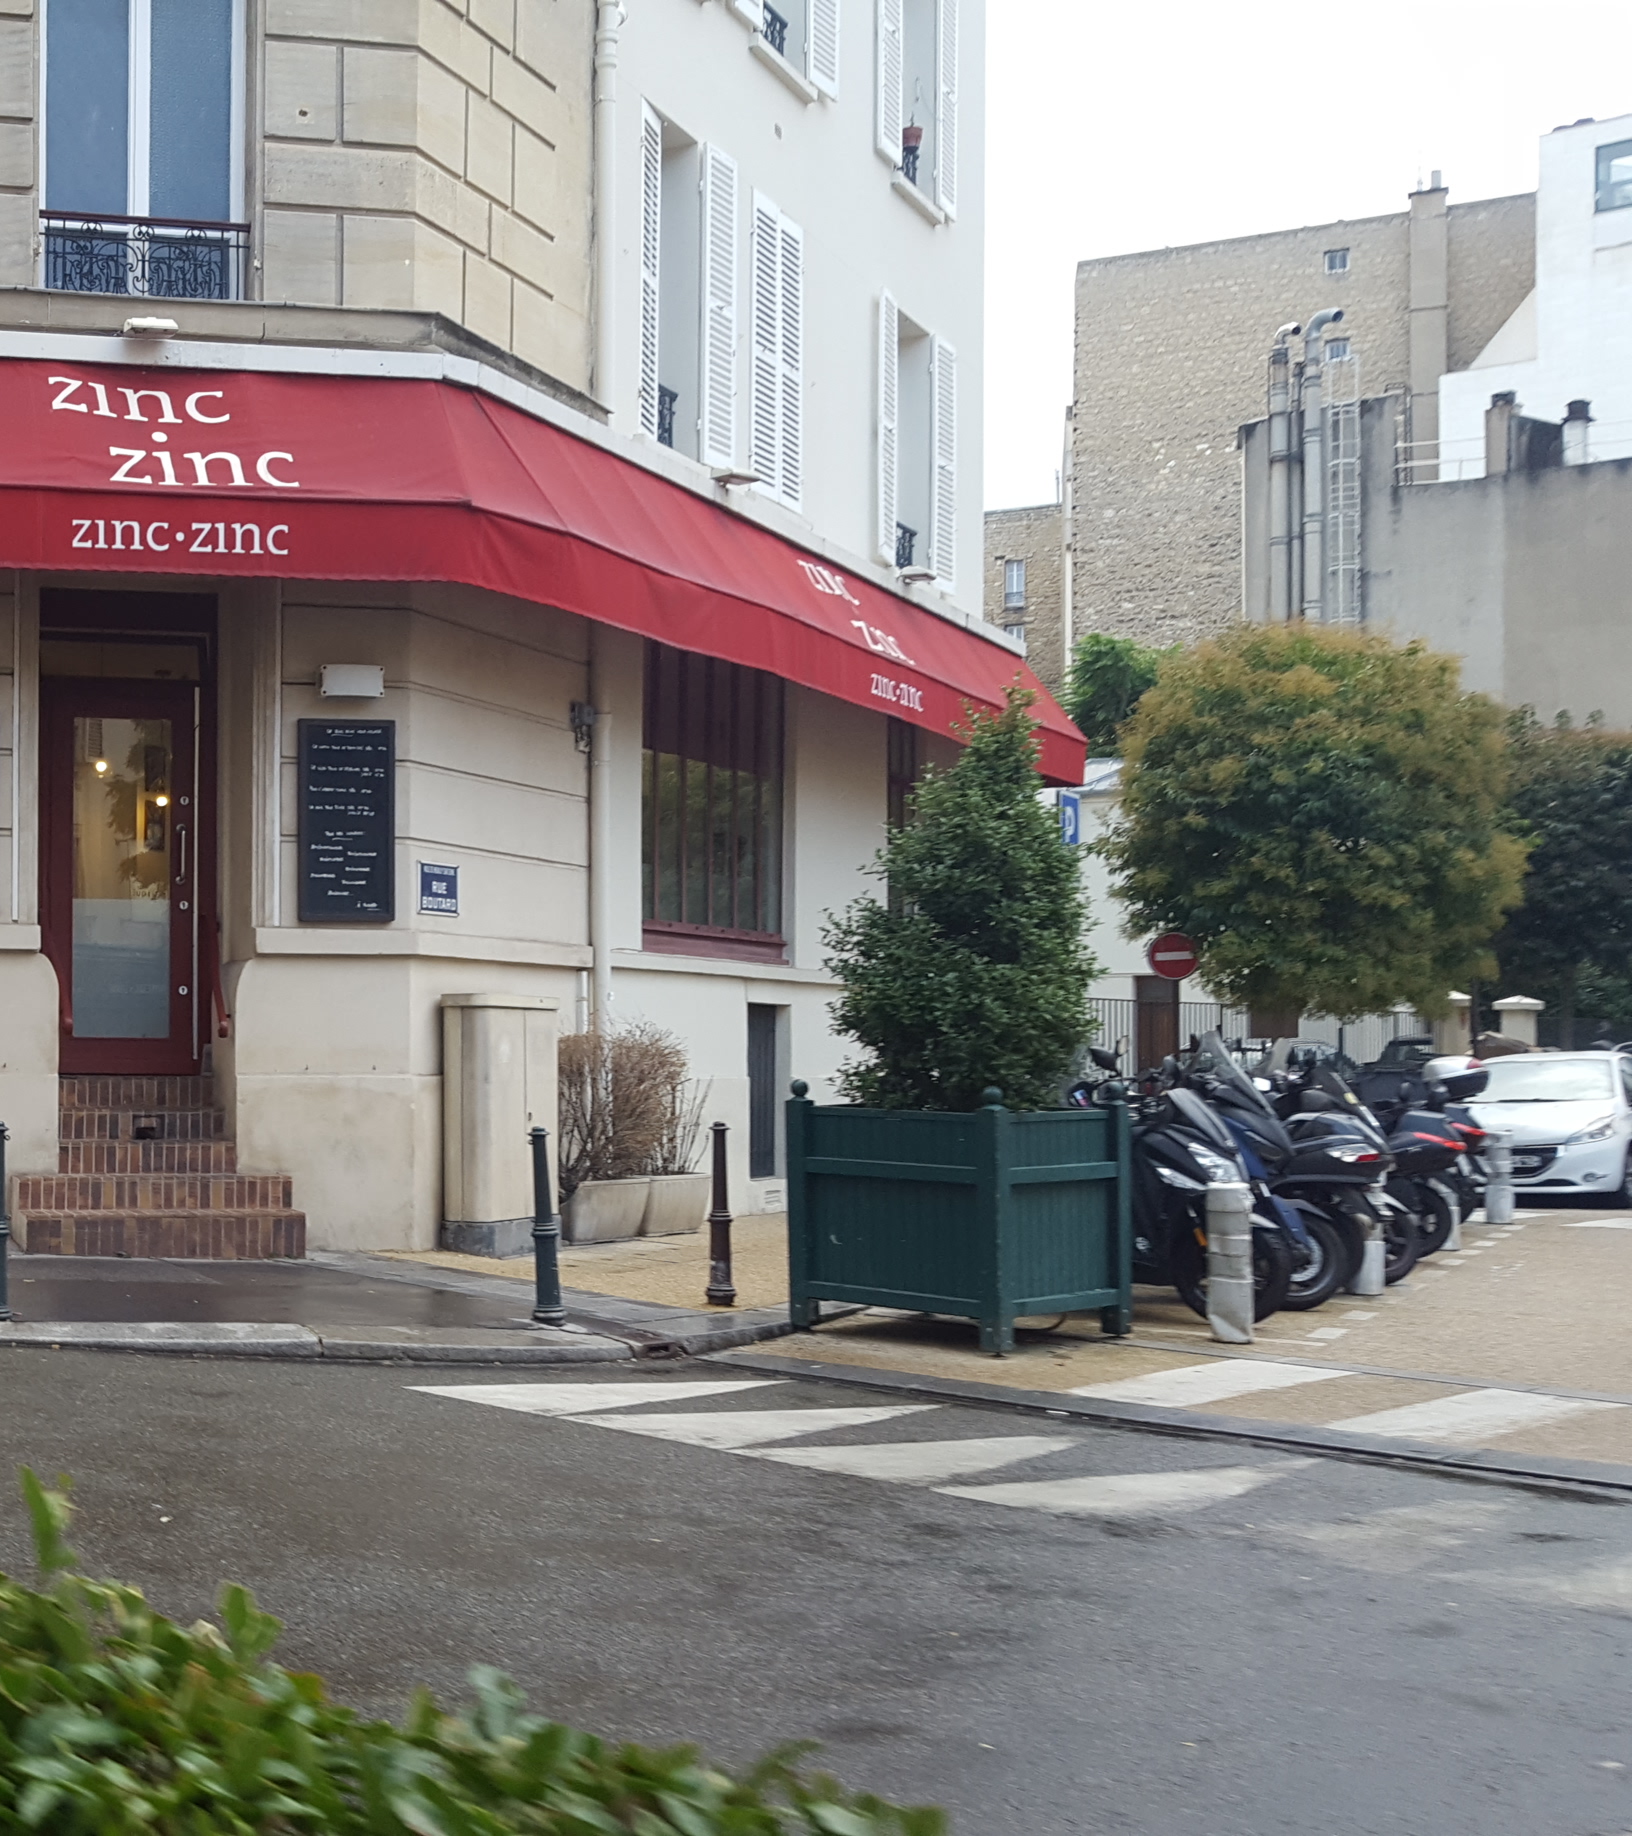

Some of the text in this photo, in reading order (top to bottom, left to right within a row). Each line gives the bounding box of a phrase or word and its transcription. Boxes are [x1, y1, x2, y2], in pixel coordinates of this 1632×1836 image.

[47, 375, 230, 425] zinc
[109, 431, 302, 489] zinc
[421, 896, 457, 911] BOUTARD
[431, 880, 448, 895] RUE
